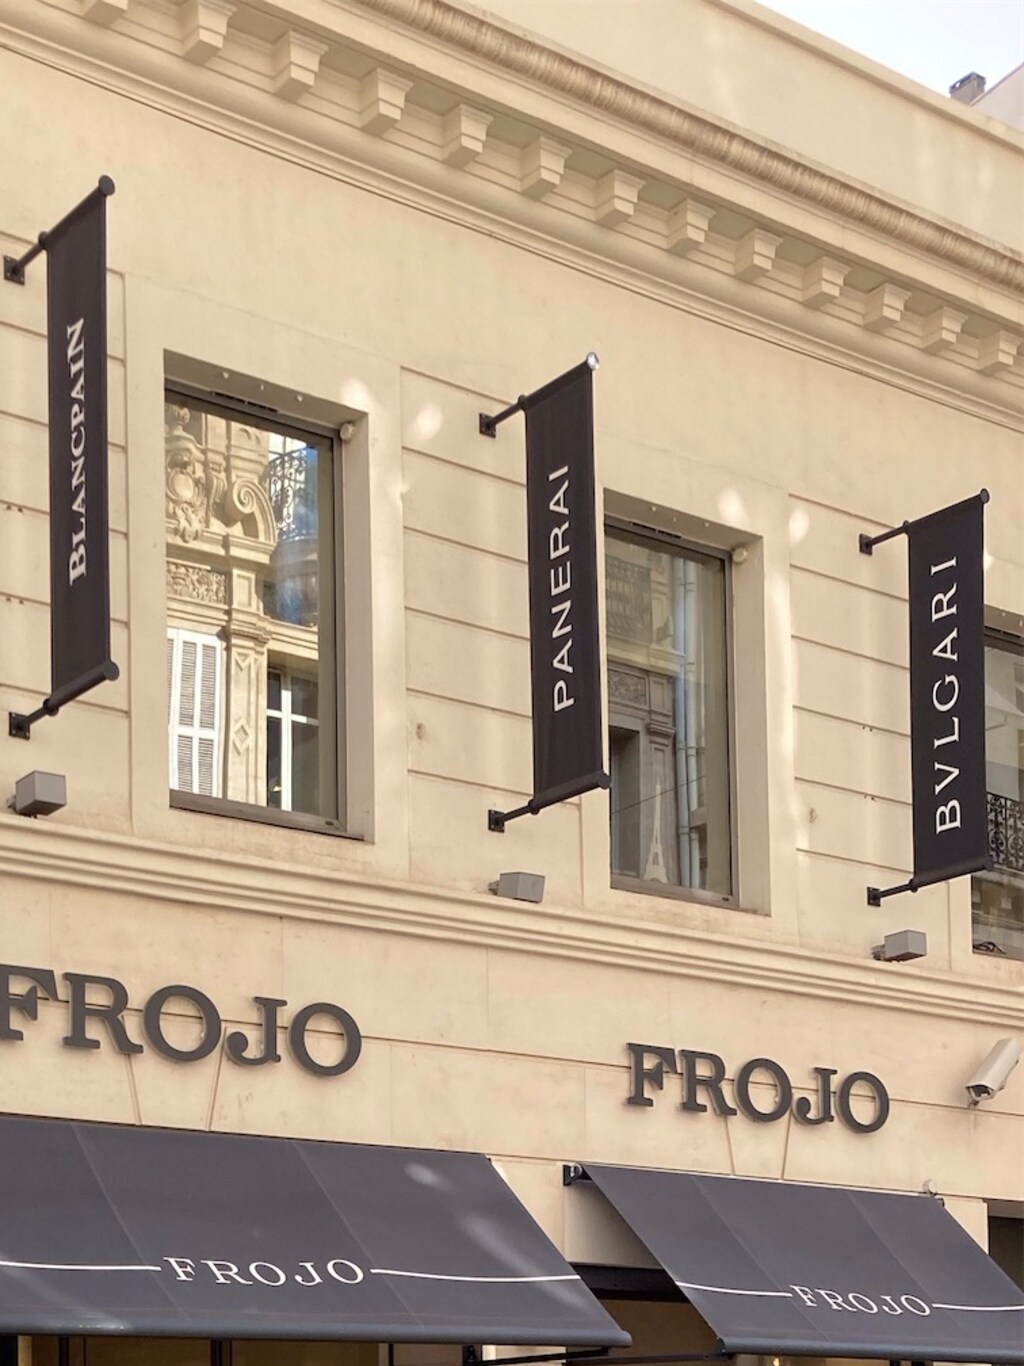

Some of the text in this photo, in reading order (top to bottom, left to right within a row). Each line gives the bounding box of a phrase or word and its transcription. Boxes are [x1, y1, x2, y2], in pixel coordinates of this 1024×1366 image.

[67, 317, 87, 587] BLANCPAIN
[548, 465, 575, 713] PANERAI
[930, 556, 962, 835] BVLGARI
[626, 1042, 890, 1133] FROJO
[163, 1257, 364, 1287] FROJO
[790, 1285, 931, 1316] FROJO
